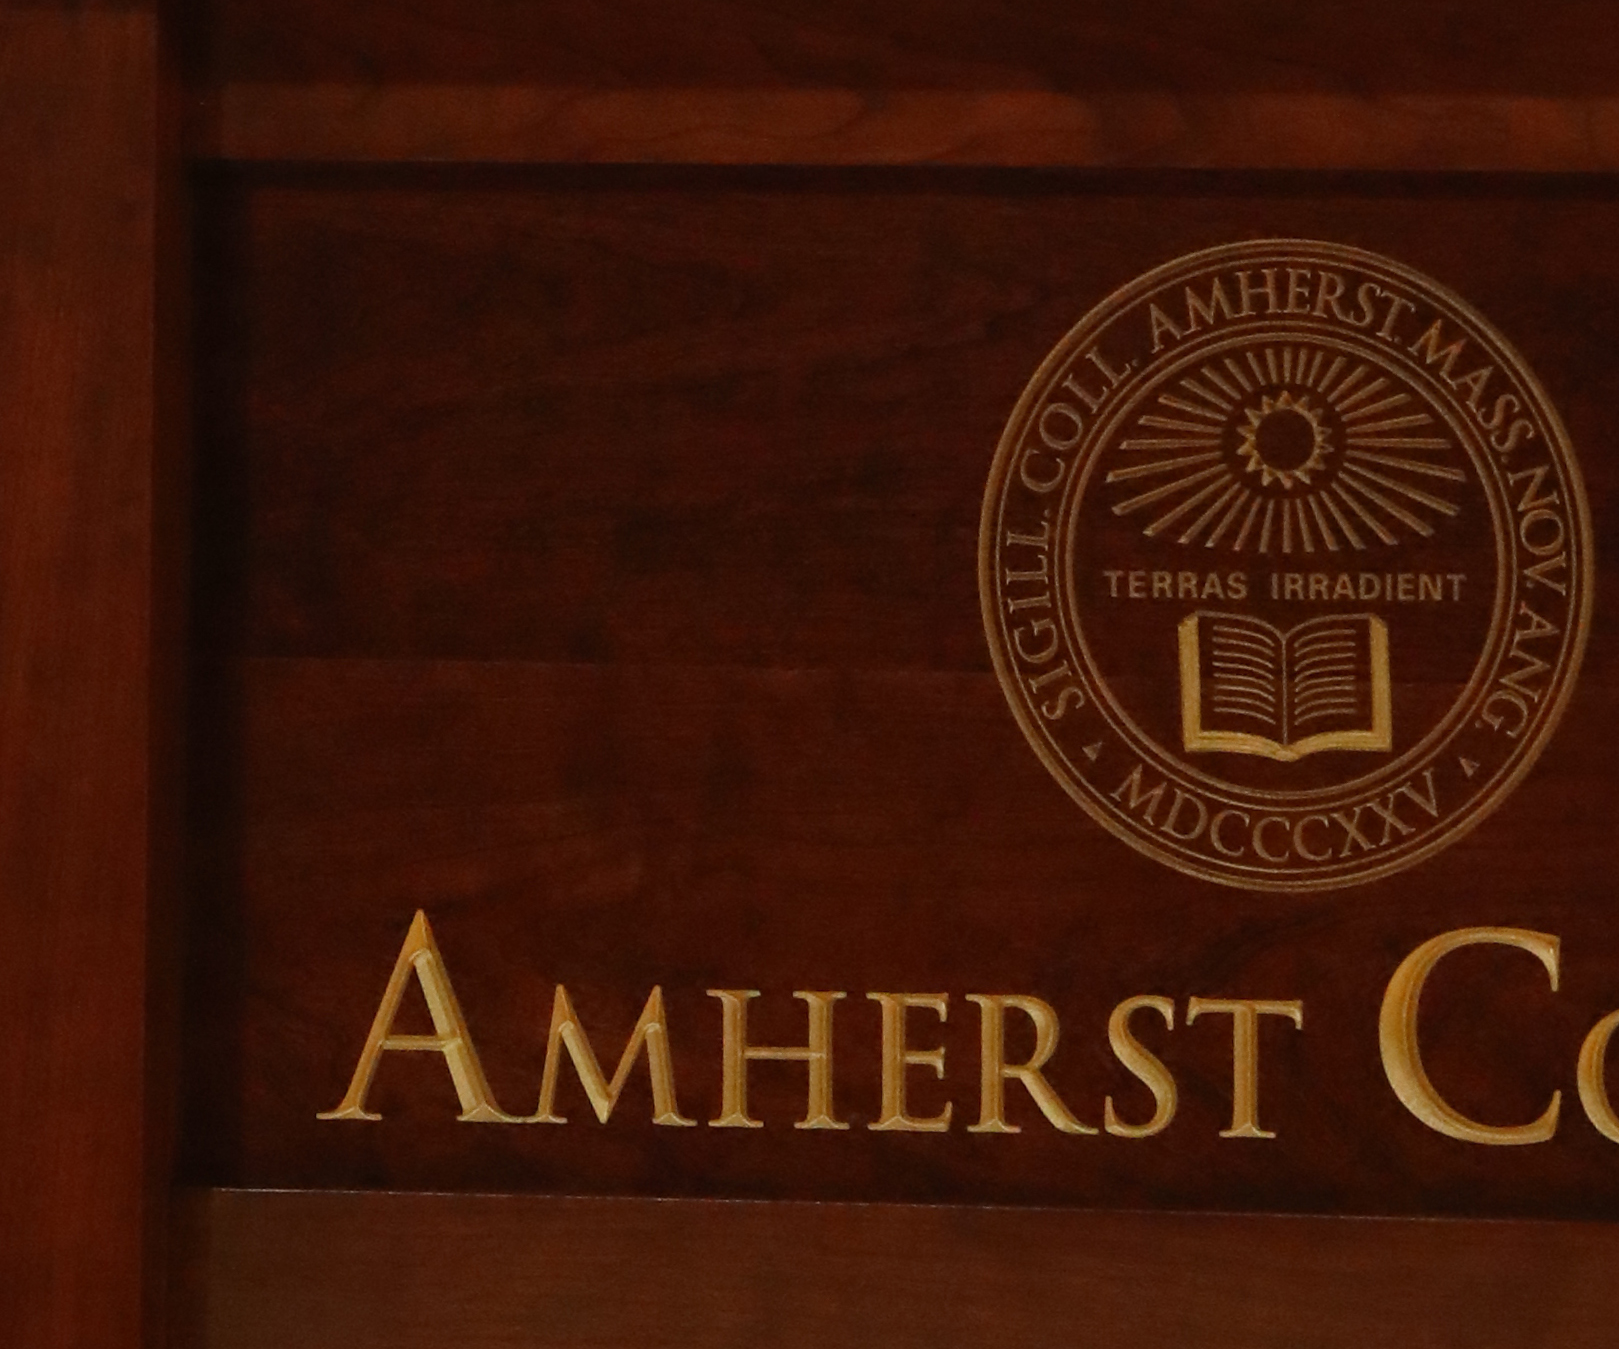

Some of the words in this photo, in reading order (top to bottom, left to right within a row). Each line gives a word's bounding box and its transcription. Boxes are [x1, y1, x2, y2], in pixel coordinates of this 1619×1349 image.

[1102, 569, 1249, 601] TERRAS
[1270, 571, 1467, 602] IRRADIENT
[1109, 763, 1439, 864] MDCCCXXV
[316, 908, 1305, 1140] AMHERST
